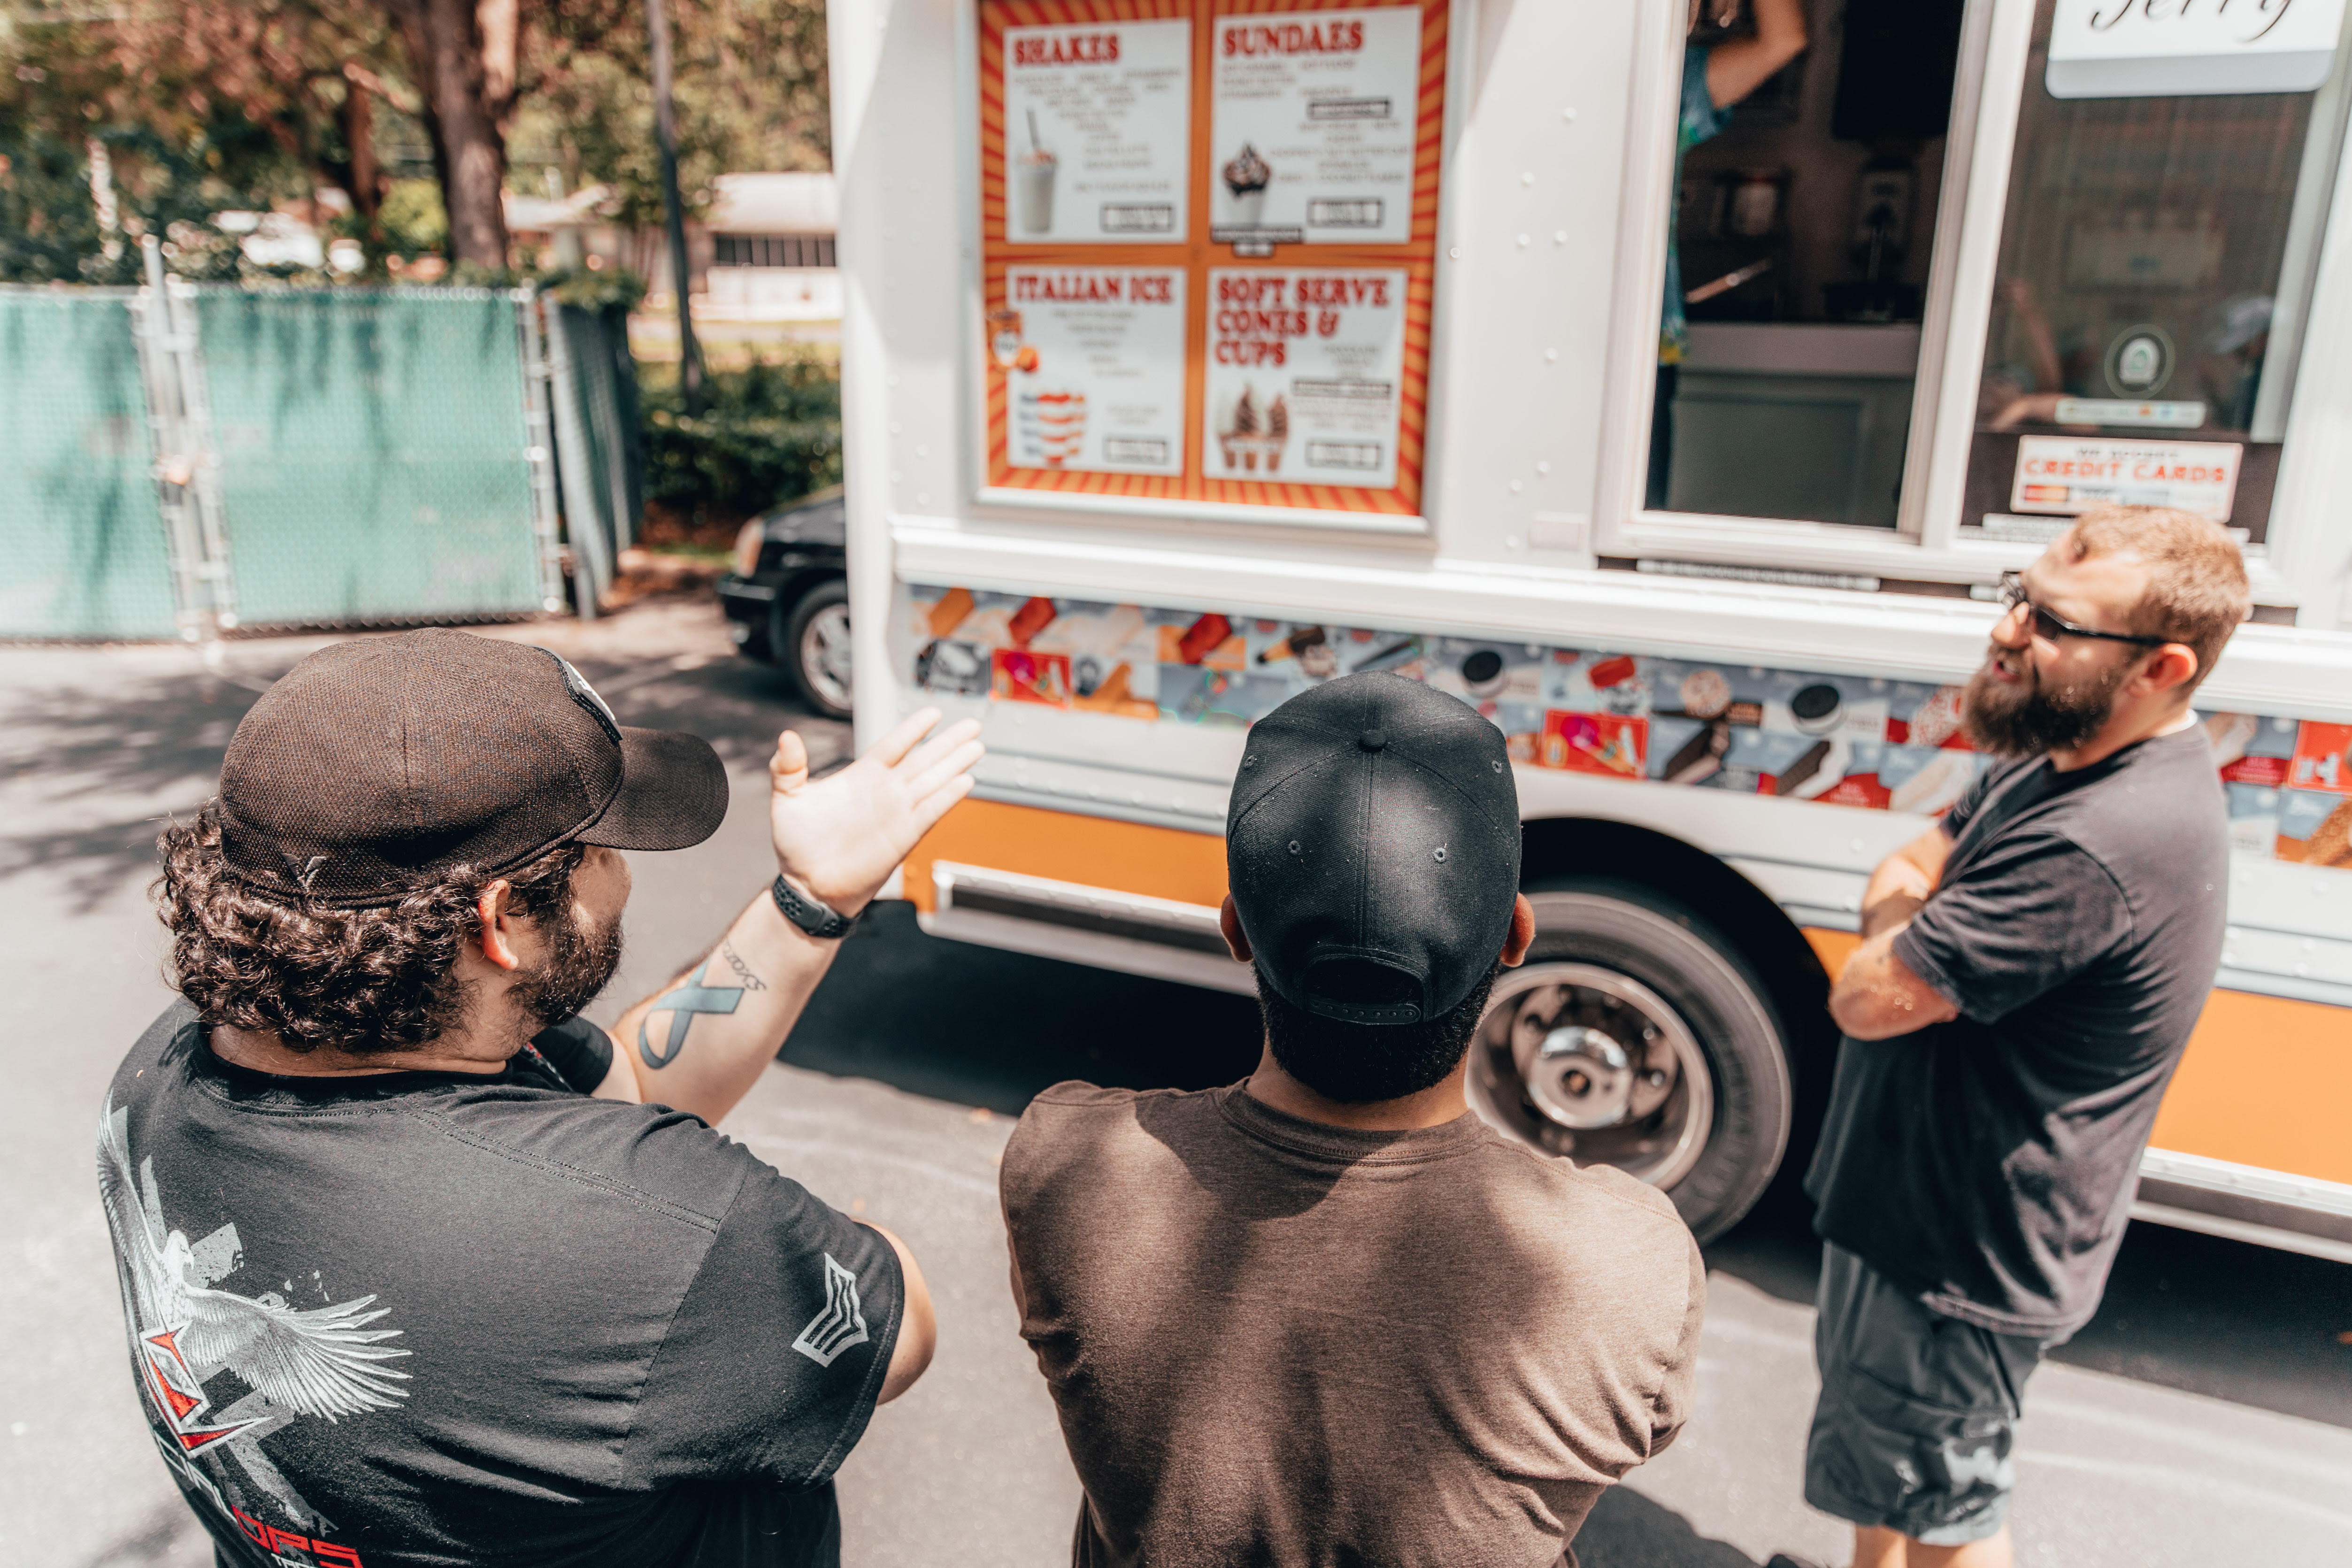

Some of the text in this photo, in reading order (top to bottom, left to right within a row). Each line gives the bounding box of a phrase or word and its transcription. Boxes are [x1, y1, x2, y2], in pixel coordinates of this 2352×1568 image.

[1013, 32, 1122, 67] SHAKES
[1222, 19, 1366, 57] SUNDAES
[1015, 274, 1174, 304] ITALIAN ICE
[1216, 275, 1391, 307] SOFT SERVE
[1214, 306, 1341, 338] CONES &
[1214, 337, 1288, 368] CUPS
[2024, 457, 2227, 483] CREDIT CARDS
[231, 1504, 364, 1568] OPS
